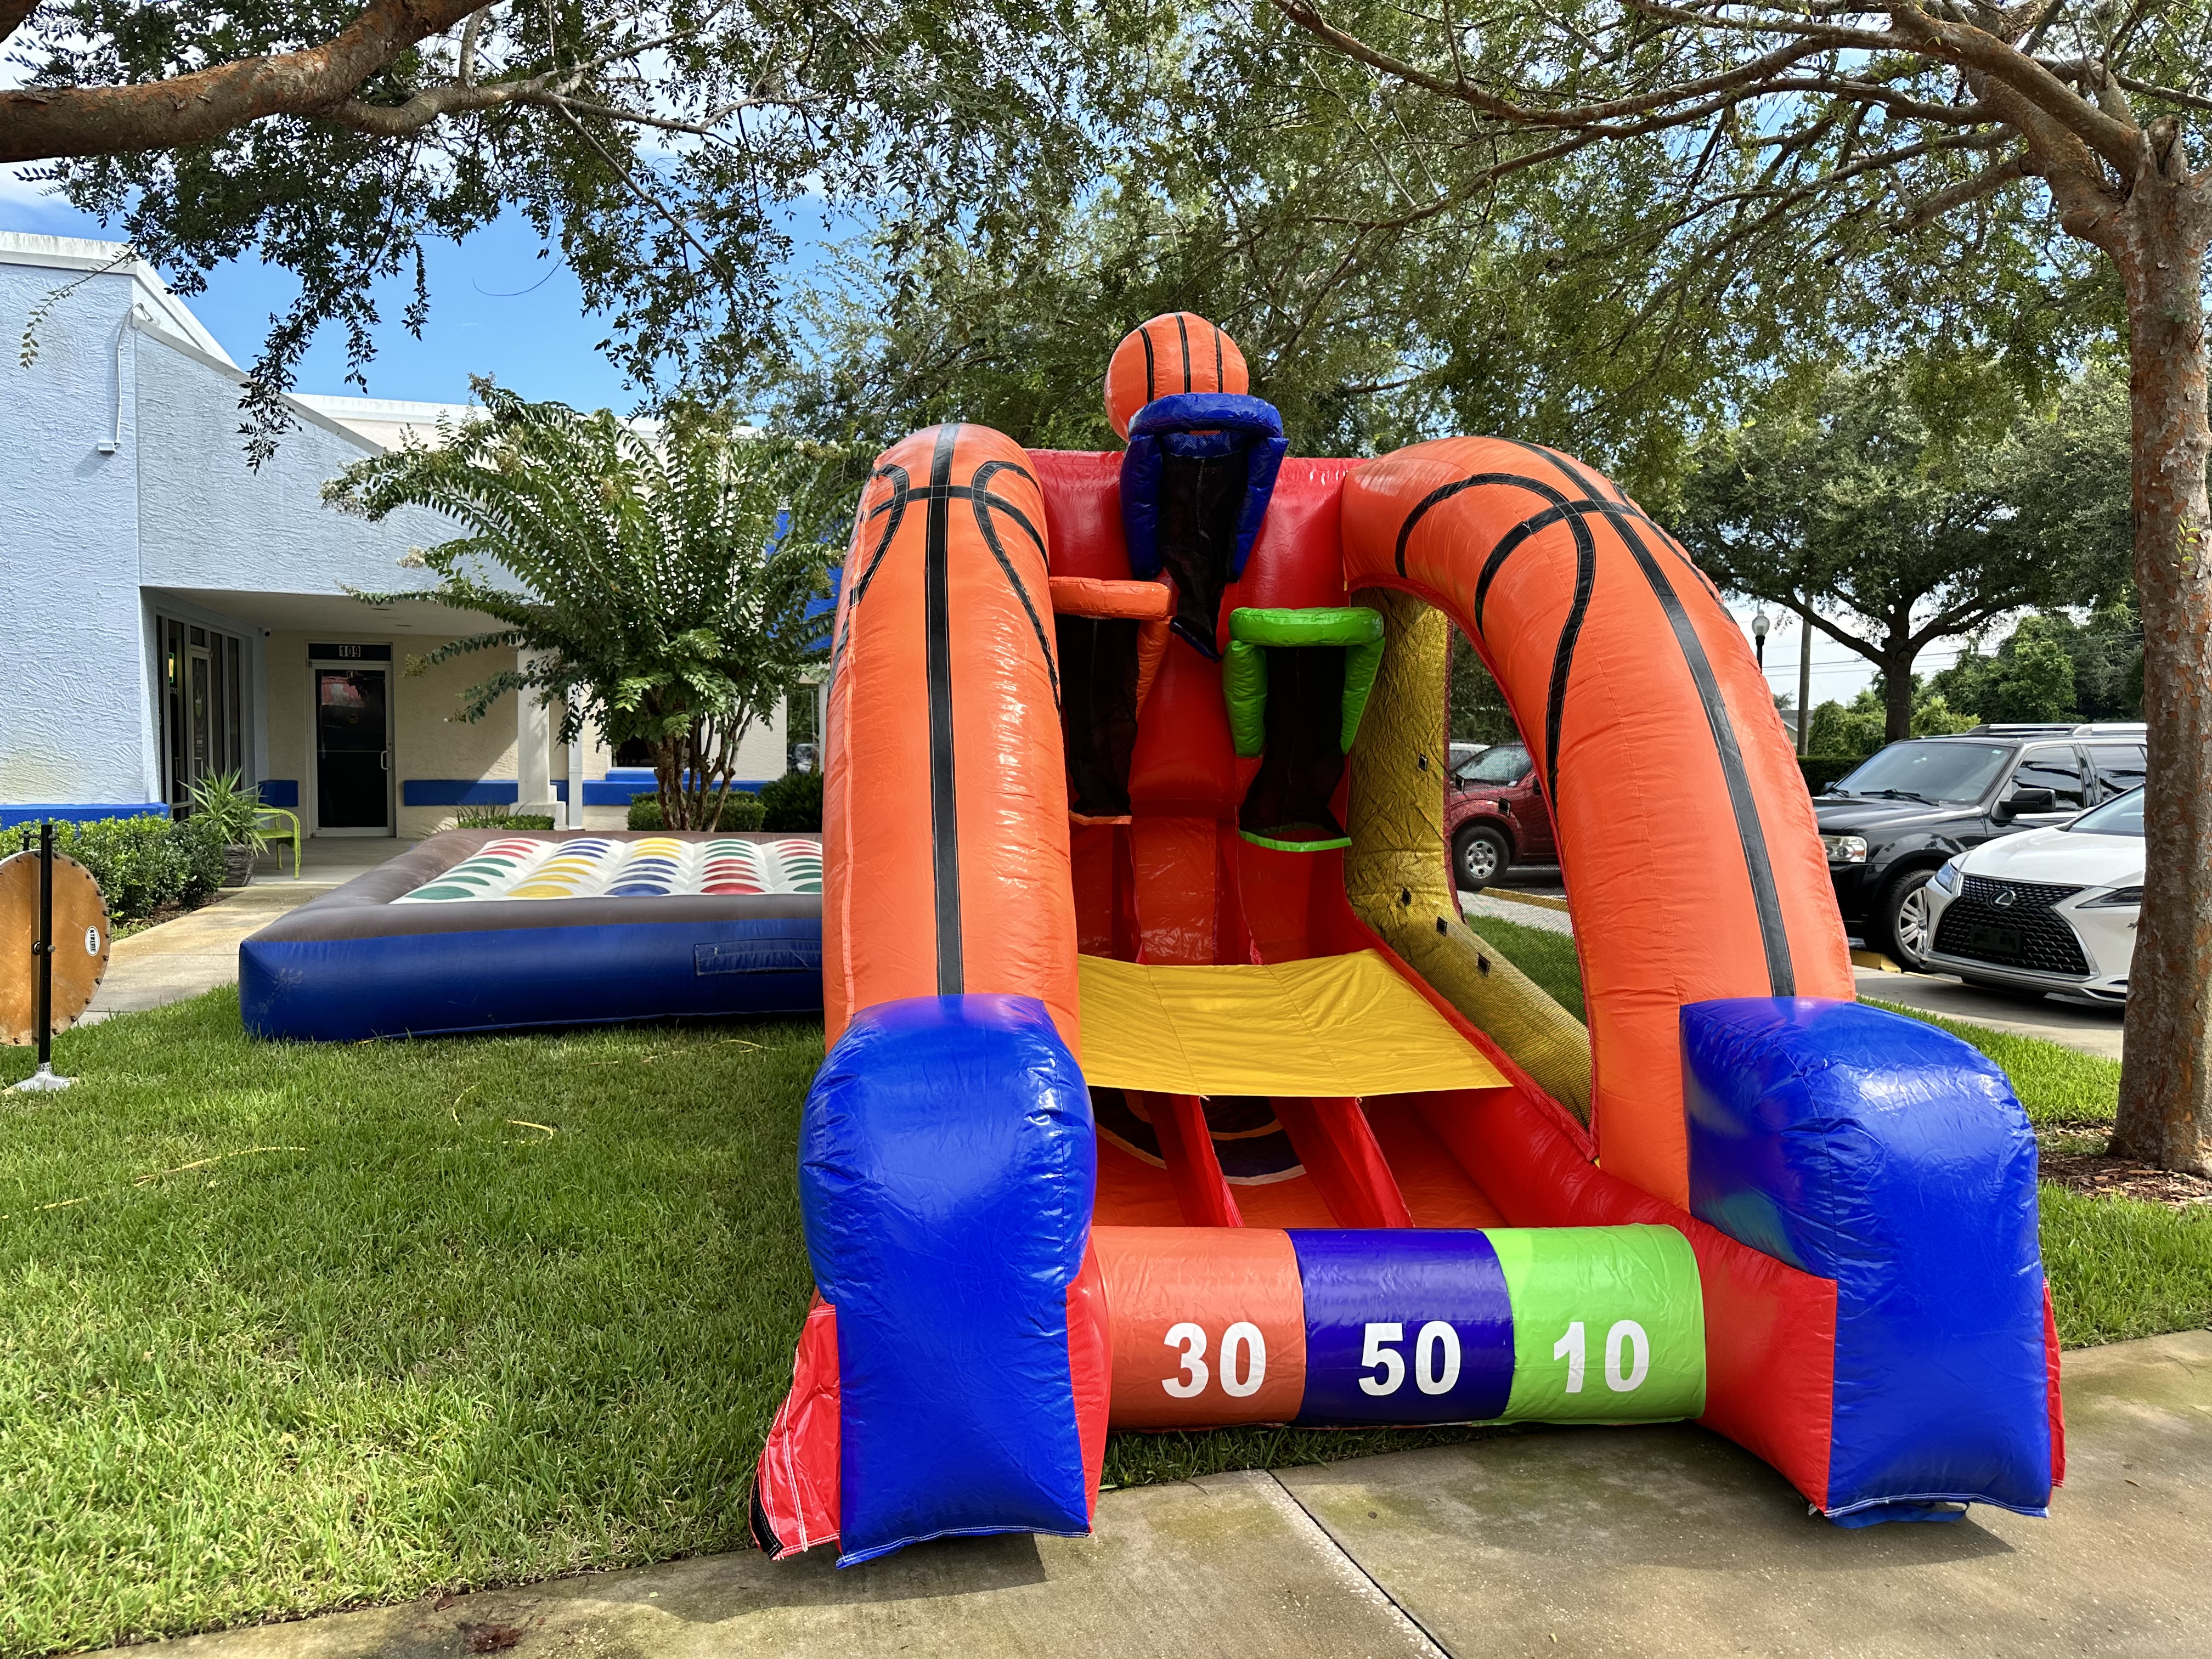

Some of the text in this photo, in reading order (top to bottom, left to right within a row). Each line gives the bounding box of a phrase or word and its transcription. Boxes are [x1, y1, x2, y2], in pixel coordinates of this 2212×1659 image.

[340, 646, 359, 657] 109
[1162, 1322, 1266, 1397] 30
[1359, 1321, 1460, 1395] 50
[1553, 1320, 1649, 1393] 10
